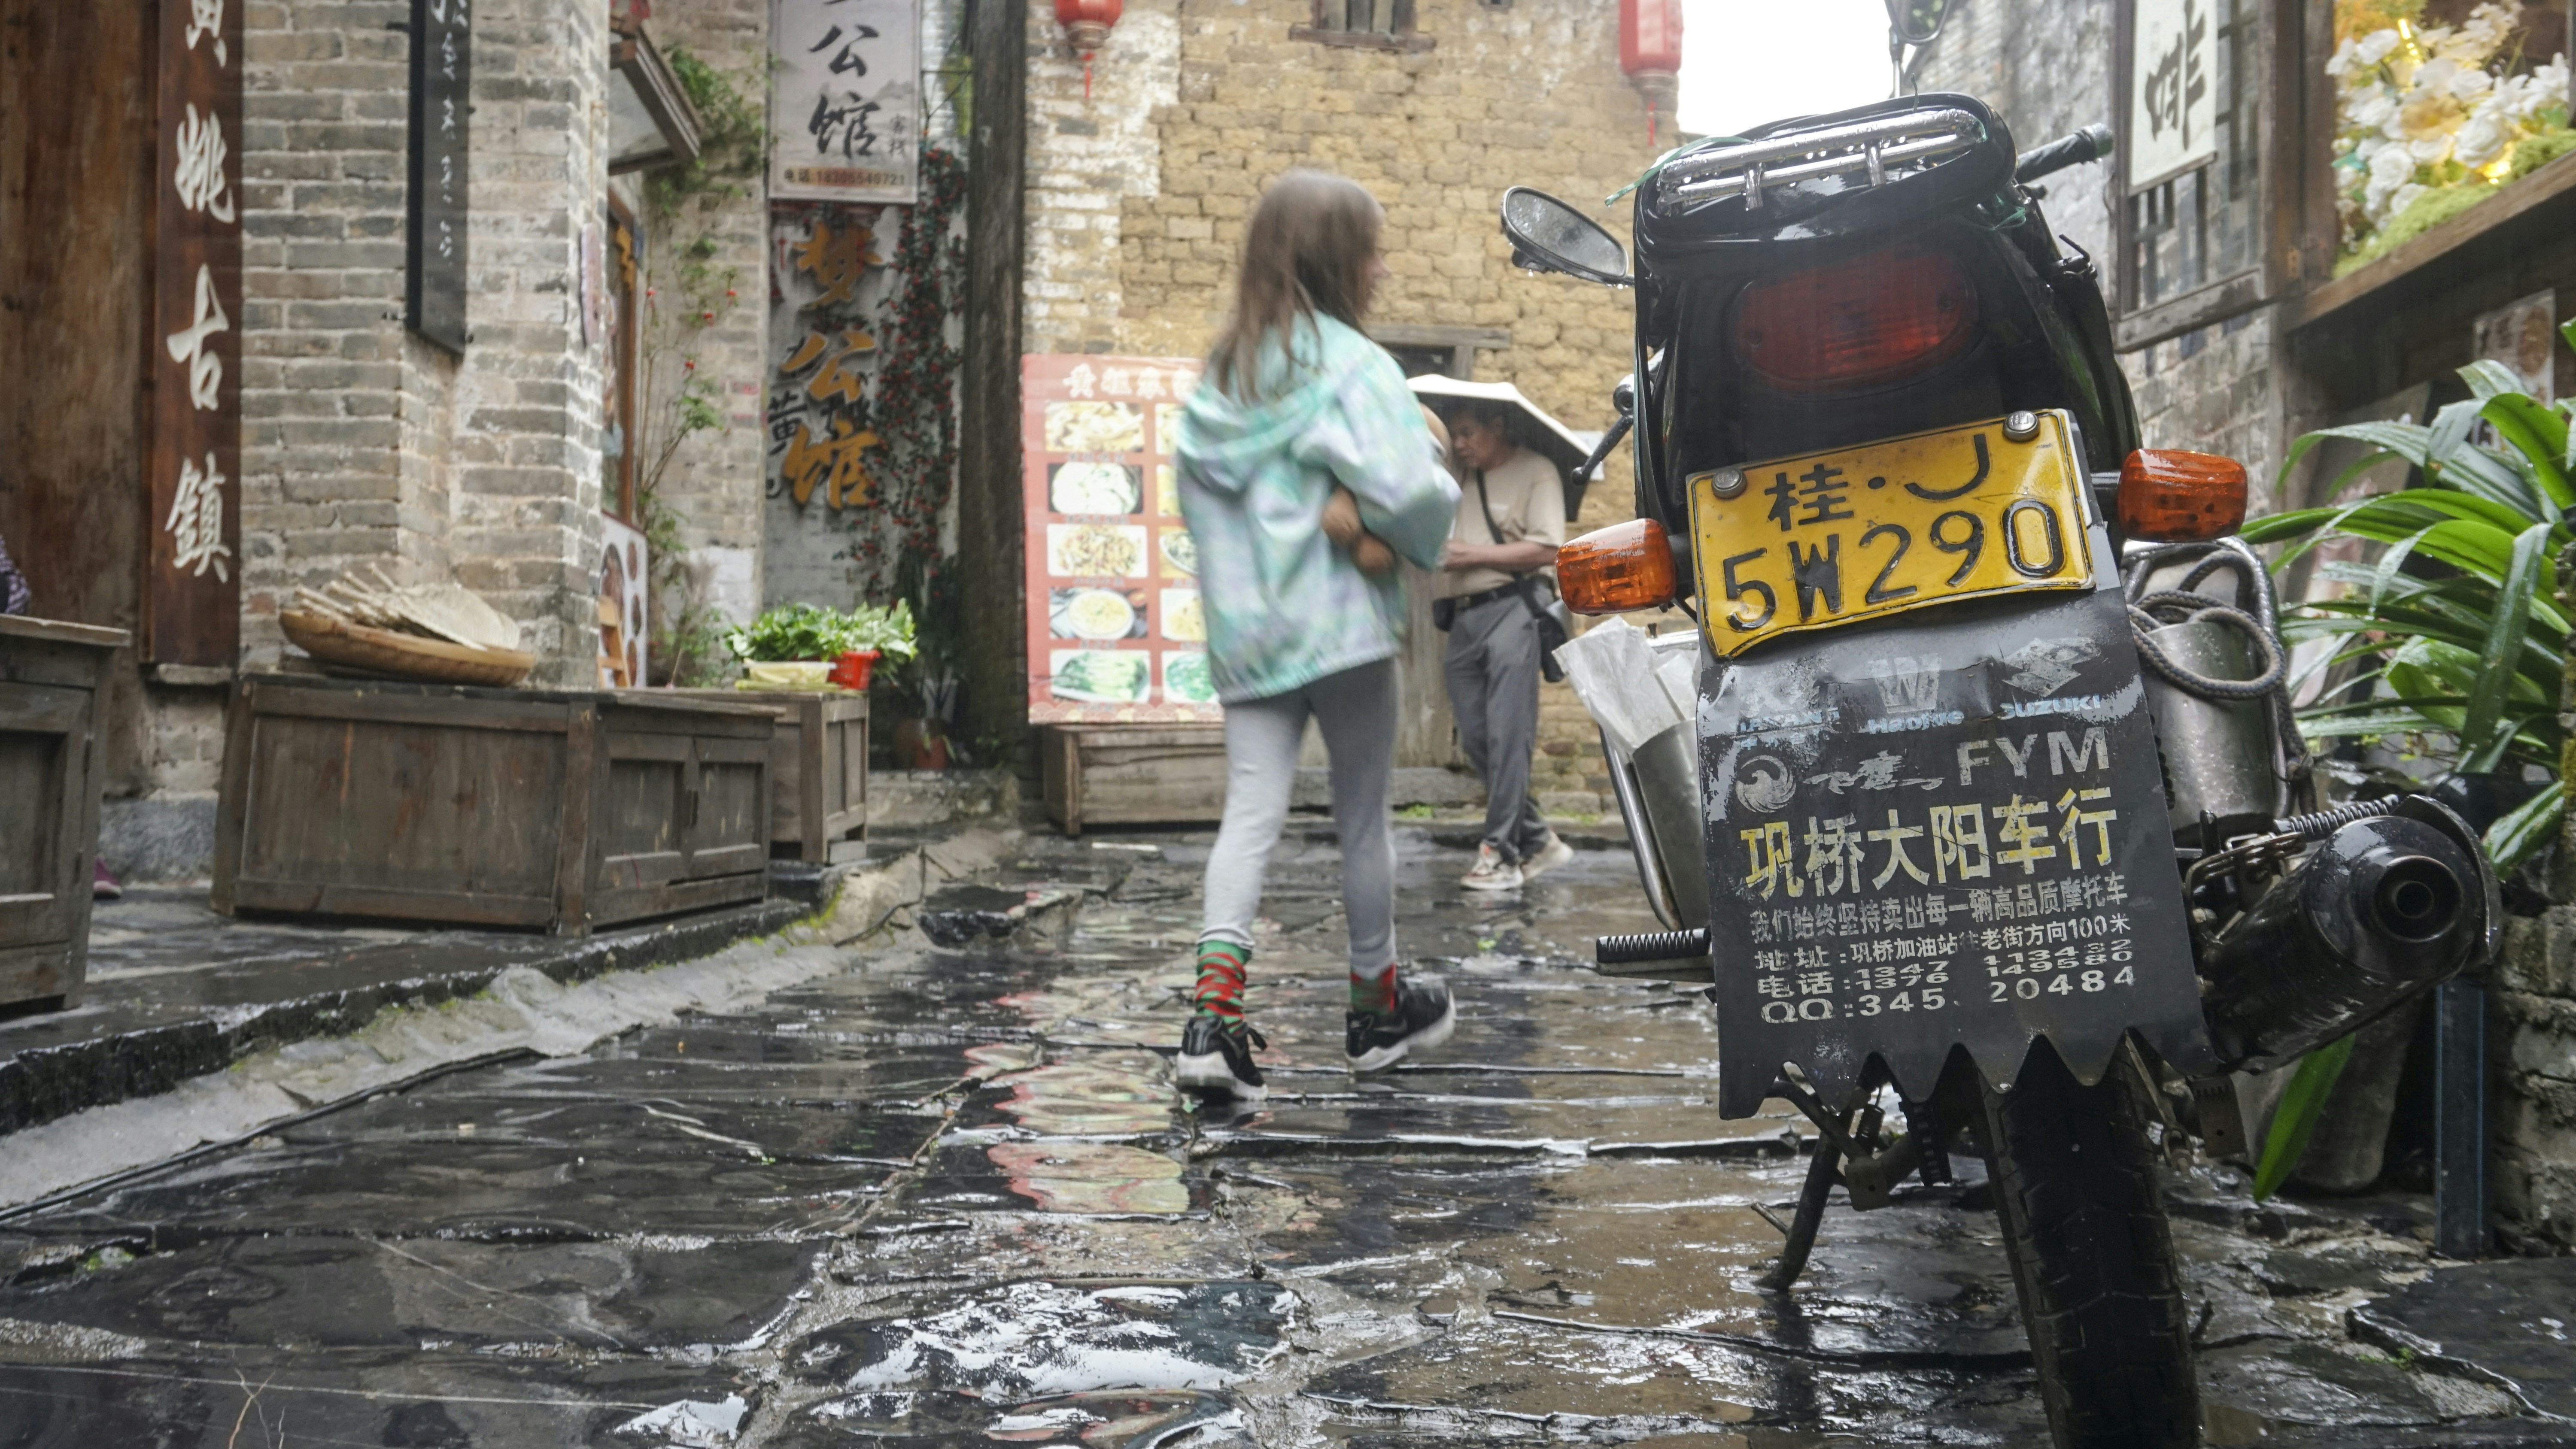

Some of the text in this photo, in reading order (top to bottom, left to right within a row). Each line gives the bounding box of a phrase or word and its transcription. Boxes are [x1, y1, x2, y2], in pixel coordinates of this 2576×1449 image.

[808, 0, 882, 159] 公馆
[1722, 498, 2066, 633] 5W290
[1956, 727, 2109, 786] FYM
[1740, 787, 2117, 901] 巩桥大阳车行
